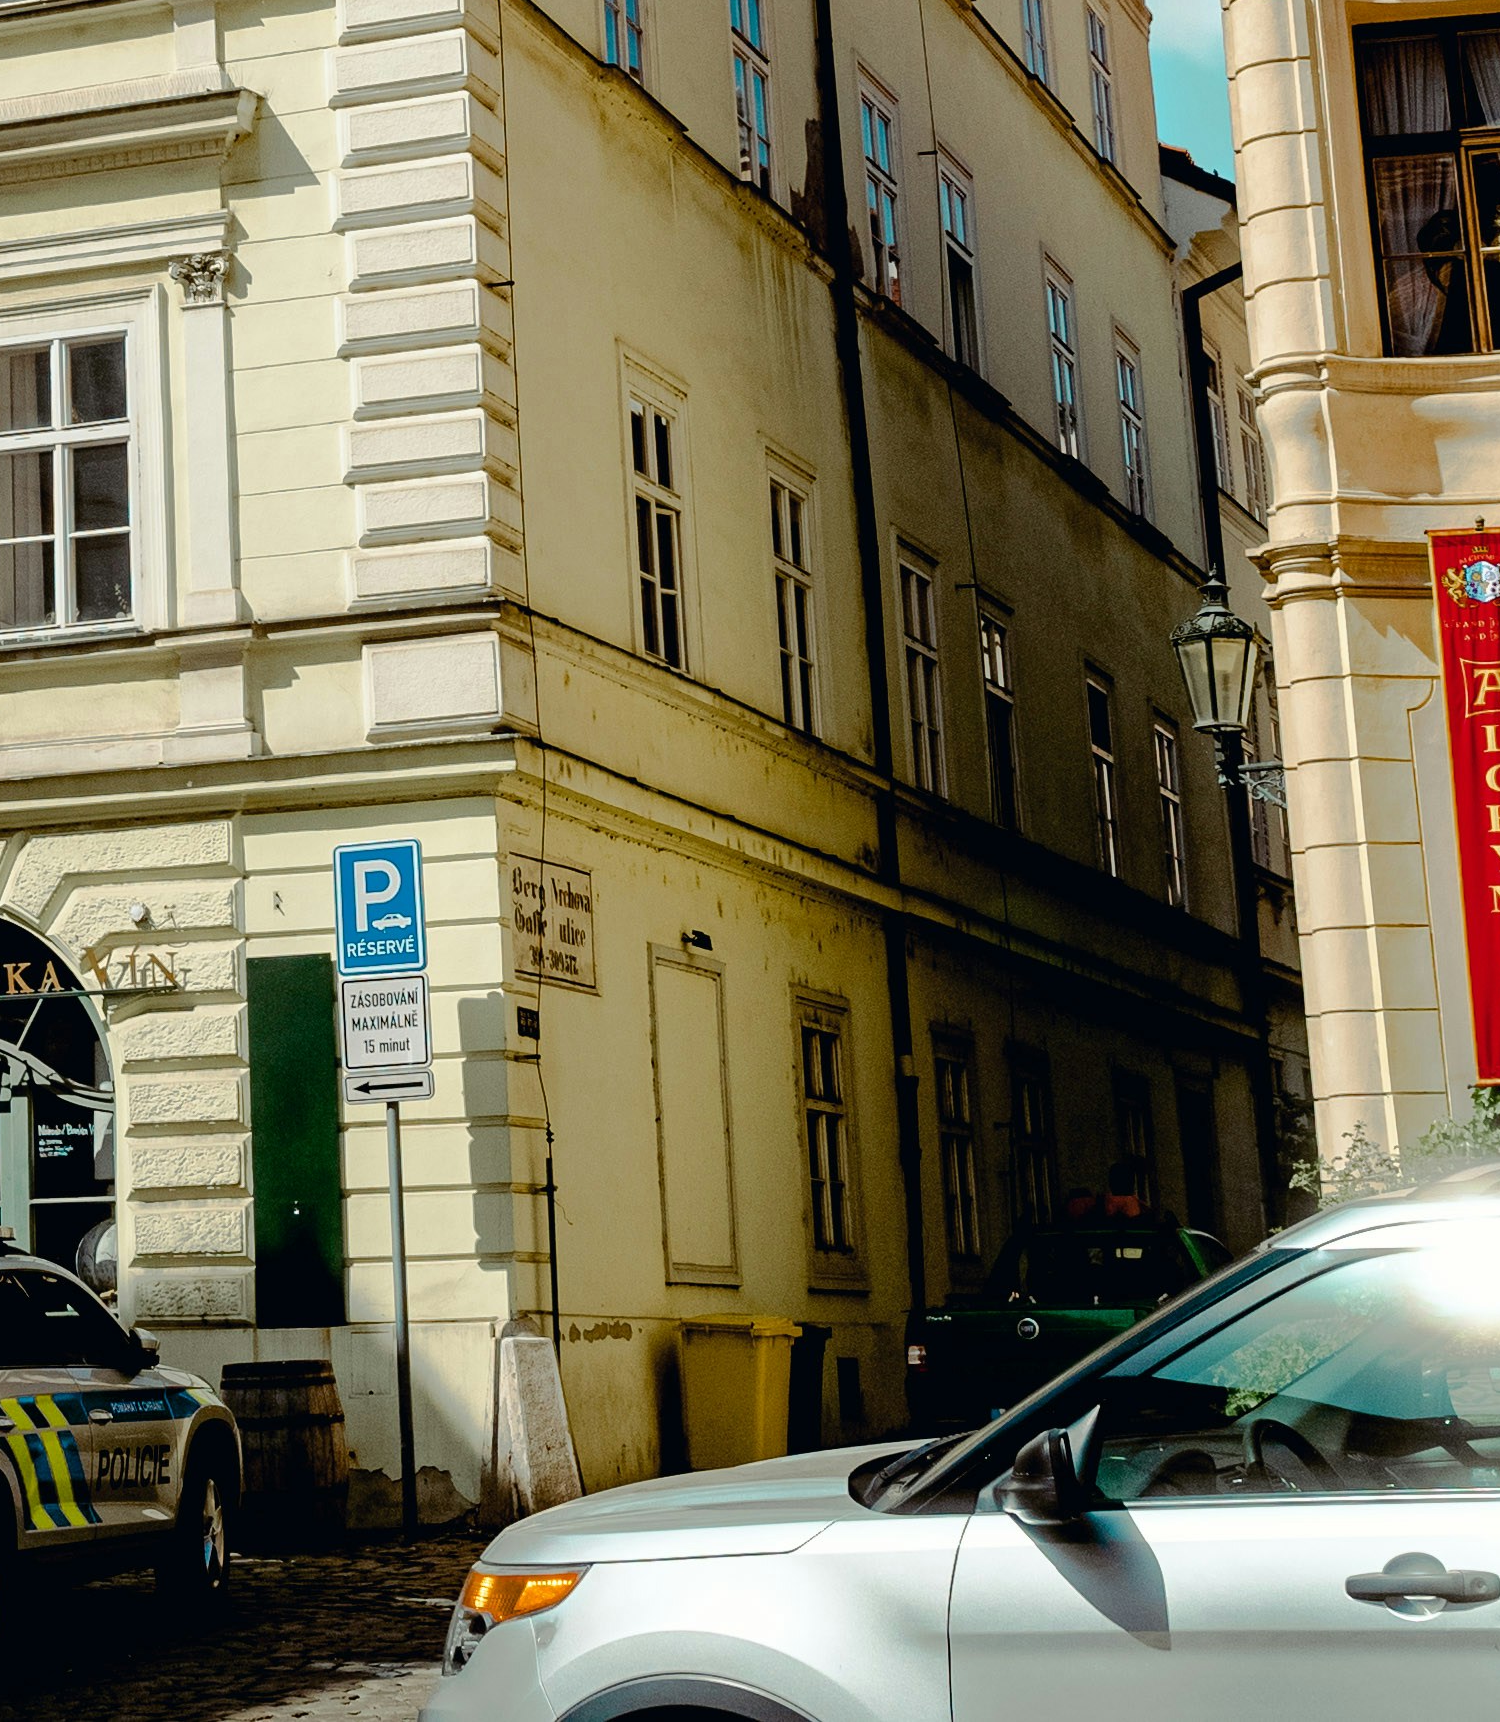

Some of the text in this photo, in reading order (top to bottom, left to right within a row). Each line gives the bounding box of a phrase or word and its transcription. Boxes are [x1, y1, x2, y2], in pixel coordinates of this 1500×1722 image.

[559, 917, 587, 949] ulice
[346, 935, 415, 958] RÉSERVÉ
[350, 987, 419, 1009] ZÁSOBOVÁNÍ
[351, 1010, 419, 1032] MAXIMÁLNĚ
[364, 1038, 411, 1054] 15 minut
[96, 1444, 171, 1492] POLICIE
